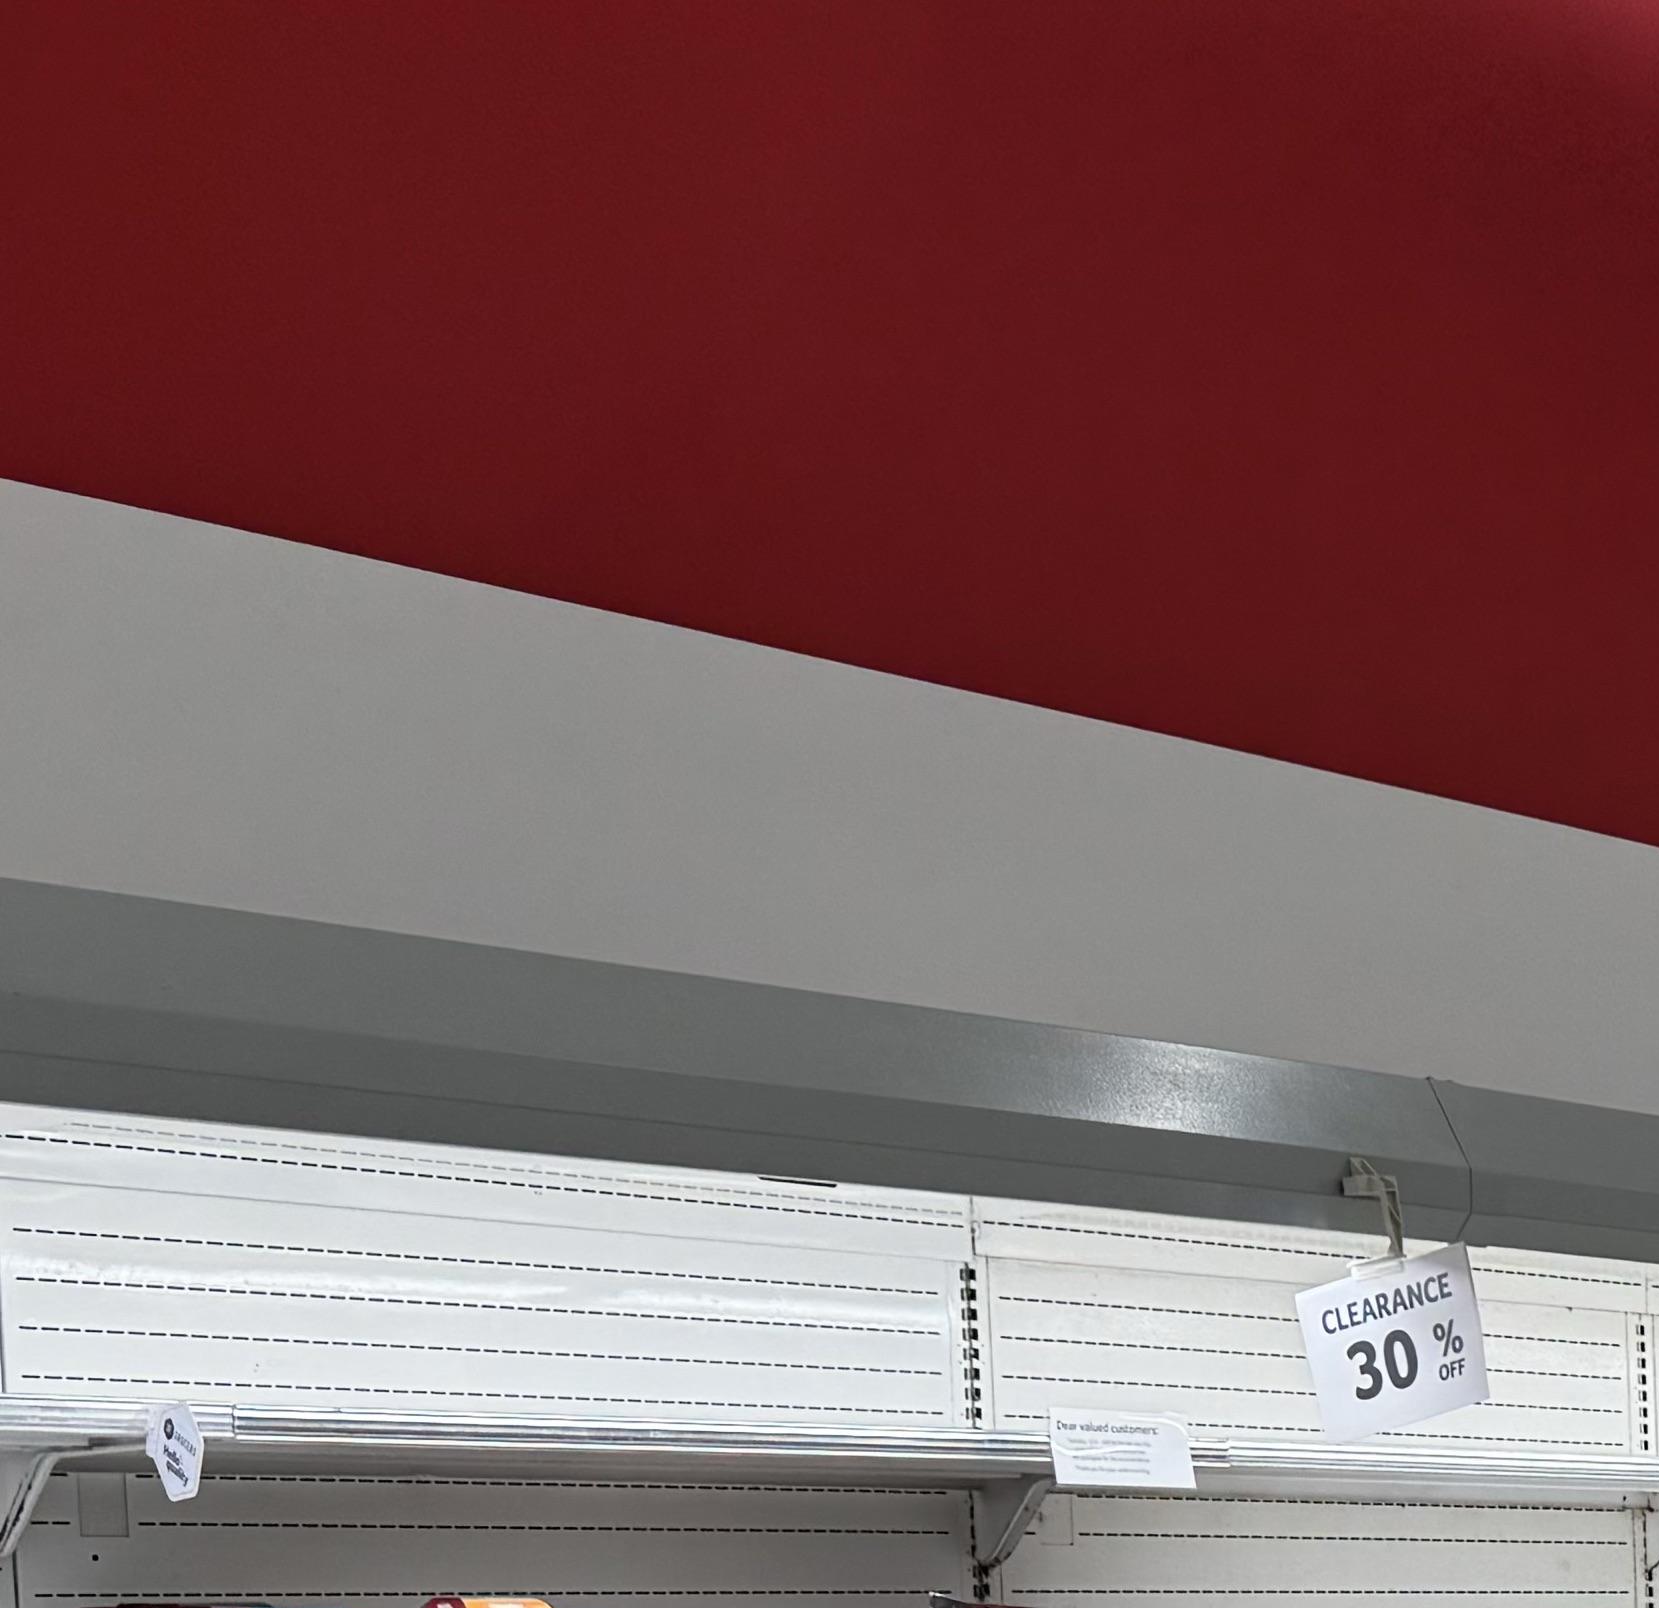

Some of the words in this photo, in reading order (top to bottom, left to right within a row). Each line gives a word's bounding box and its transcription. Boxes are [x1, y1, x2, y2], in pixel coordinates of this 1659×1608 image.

[1321, 1272, 1453, 1335] CLEARANCE
[1346, 1329, 1419, 1400] 30
[1433, 1318, 1465, 1358] %
[1438, 1357, 1466, 1381] OFF
[1056, 1420, 1077, 1431] Dear
[1079, 1421, 1109, 1433] valued
